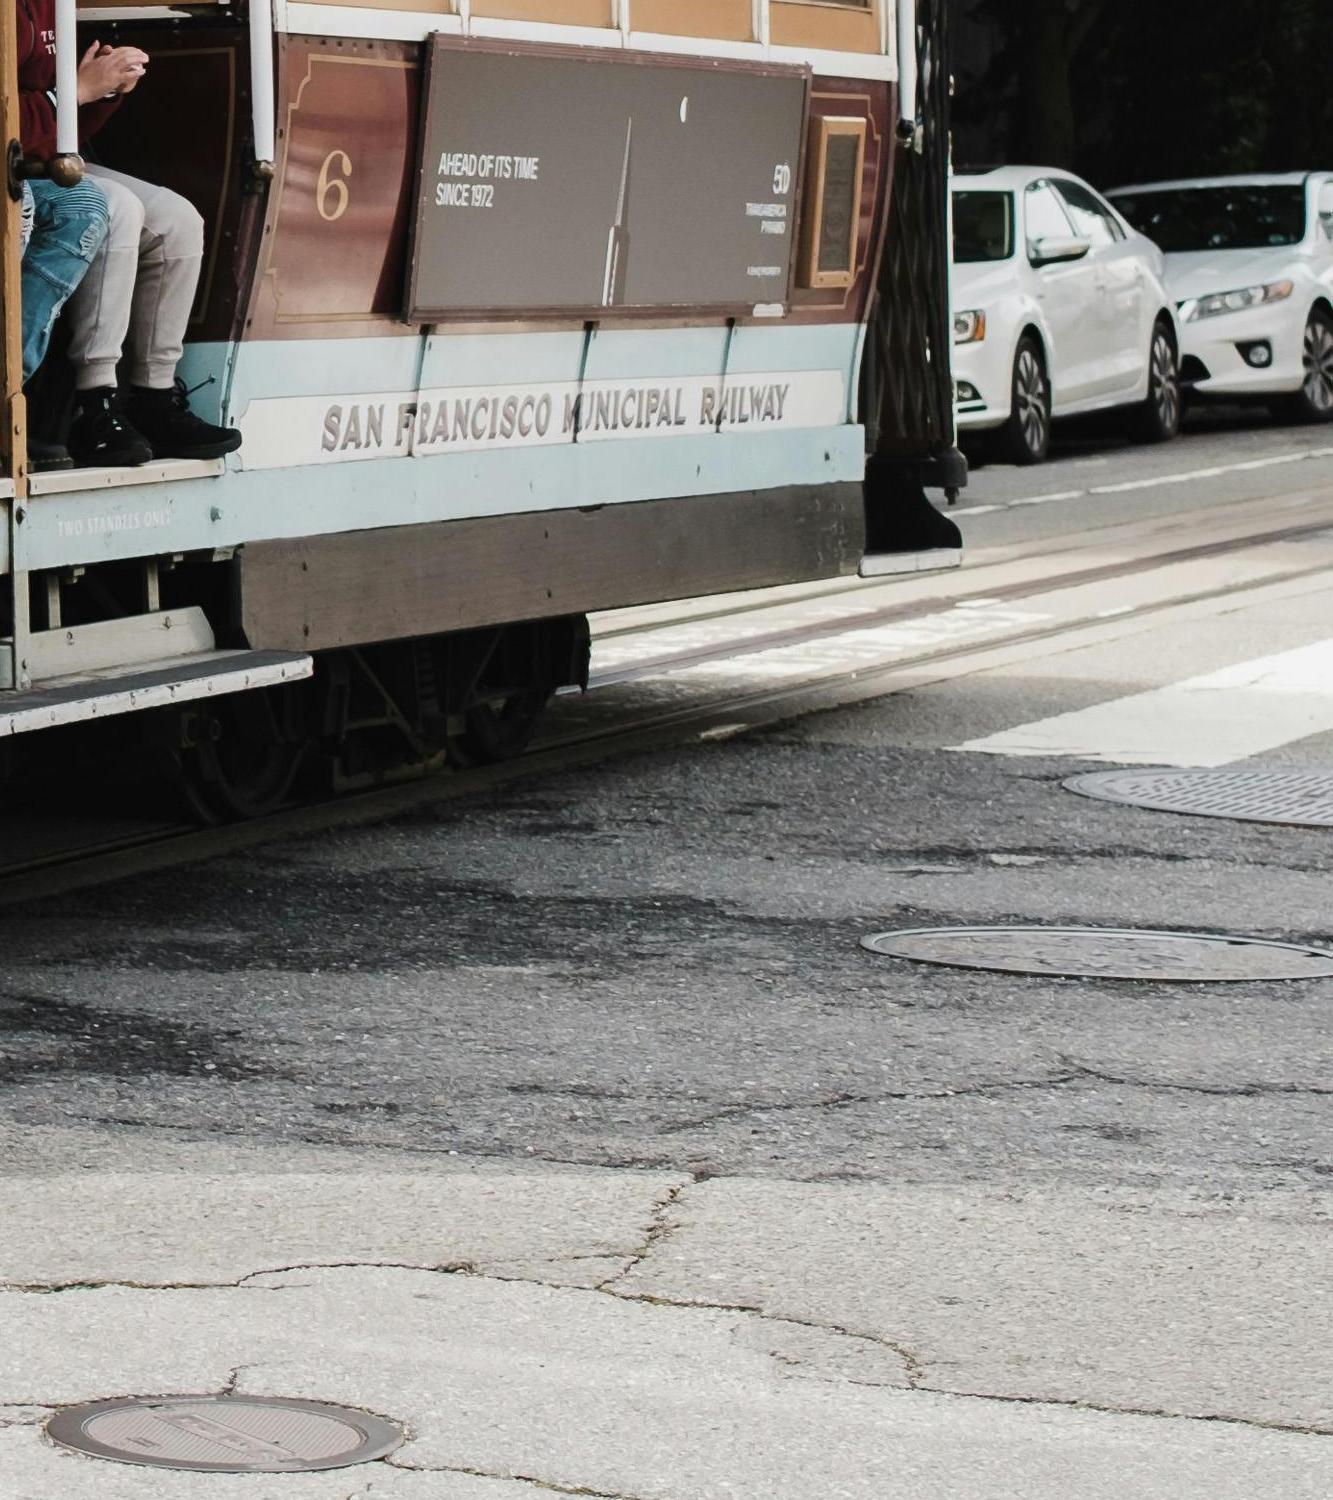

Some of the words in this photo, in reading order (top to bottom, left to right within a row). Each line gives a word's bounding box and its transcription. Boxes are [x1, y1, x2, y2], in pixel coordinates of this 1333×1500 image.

[316, 150, 353, 222] 6
[438, 152, 476, 176] AHEAD
[478, 155, 494, 177] OF
[495, 156, 512, 179] ITS
[514, 156, 539, 179] TIME
[322, 402, 385, 452] SAN
[395, 390, 552, 446] FRANCISCO
[563, 386, 687, 434] MUNICIPAL
[699, 383, 790, 424] RAILWAY
